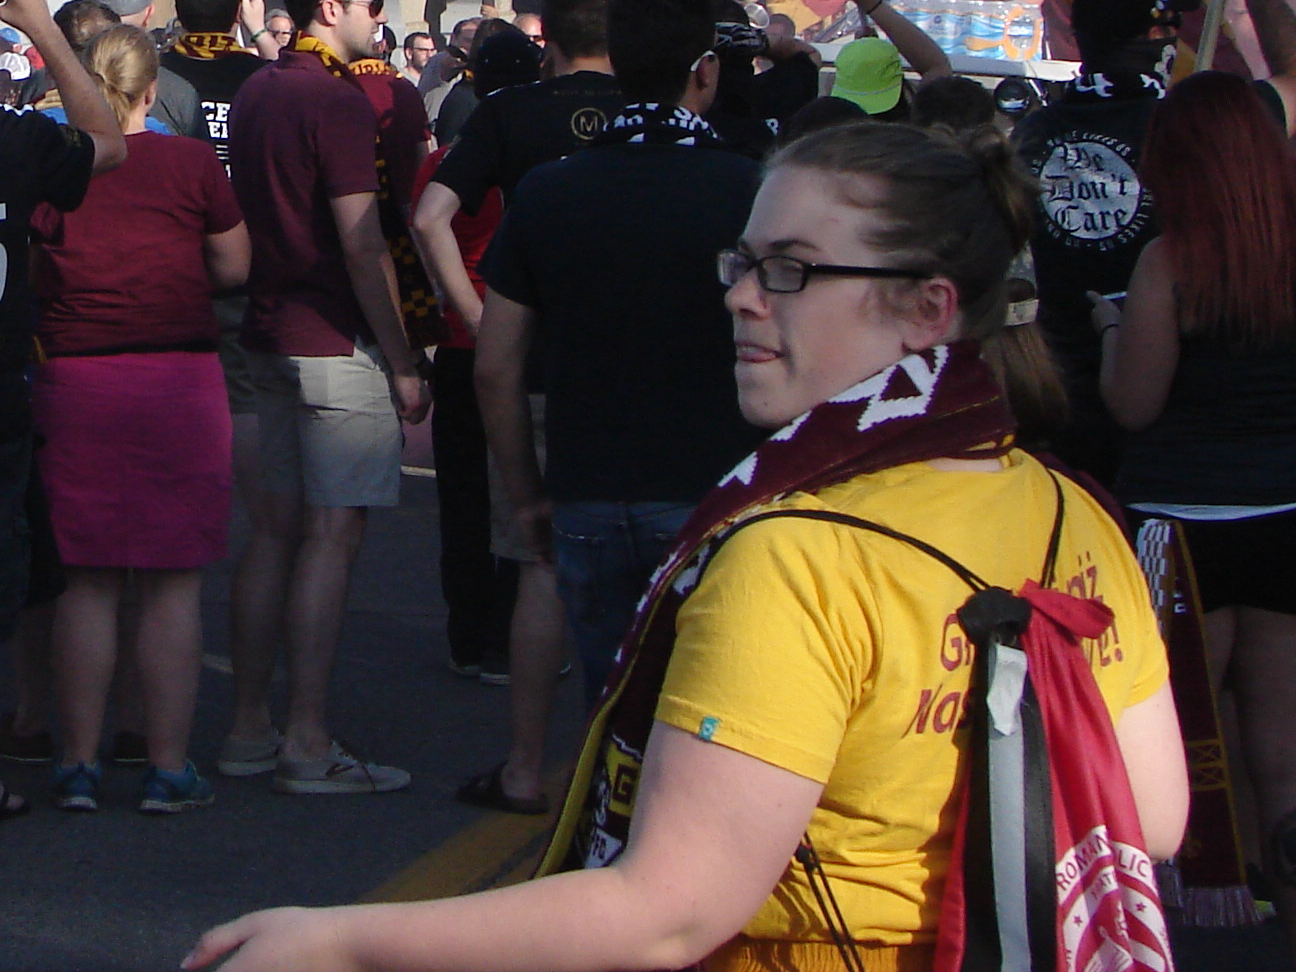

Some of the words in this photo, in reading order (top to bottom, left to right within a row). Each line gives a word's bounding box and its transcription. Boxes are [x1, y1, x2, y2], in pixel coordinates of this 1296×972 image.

[1059, 145, 1105, 172] We
[1045, 173, 1129, 203] Don't
[1055, 205, 1127, 233] Care
